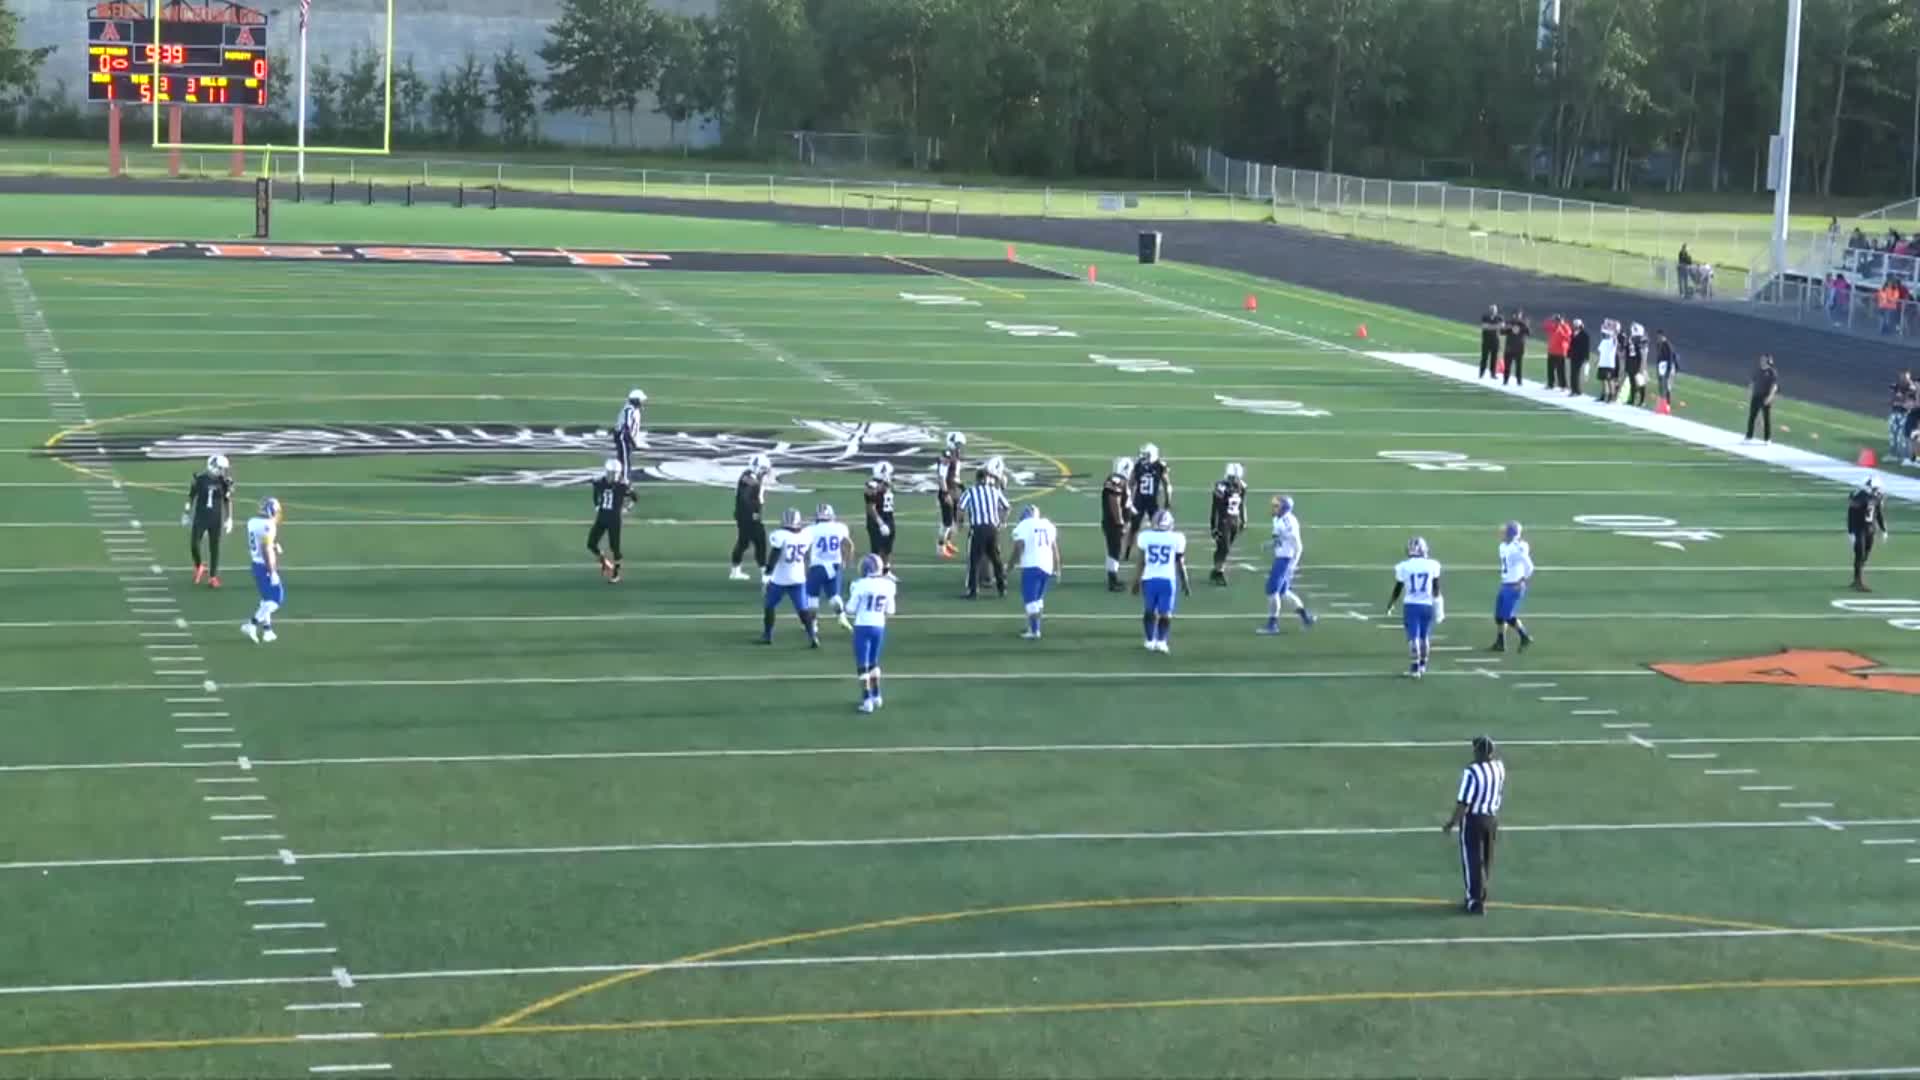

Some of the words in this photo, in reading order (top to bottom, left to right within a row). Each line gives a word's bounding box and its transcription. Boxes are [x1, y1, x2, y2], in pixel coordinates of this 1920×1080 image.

[99, 55, 111, 73] 0
[253, 60, 265, 78] 0
[159, 77, 168, 92] 3
[187, 78, 195, 92] 3
[140, 85, 151, 103] 5
[208, 87, 225, 103] 11
[1140, 477, 1154, 496] 21
[205, 487, 215, 508] 1
[785, 543, 805, 563] 35
[1146, 544, 1172, 566] 55
[1408, 572, 1430, 595] 17
